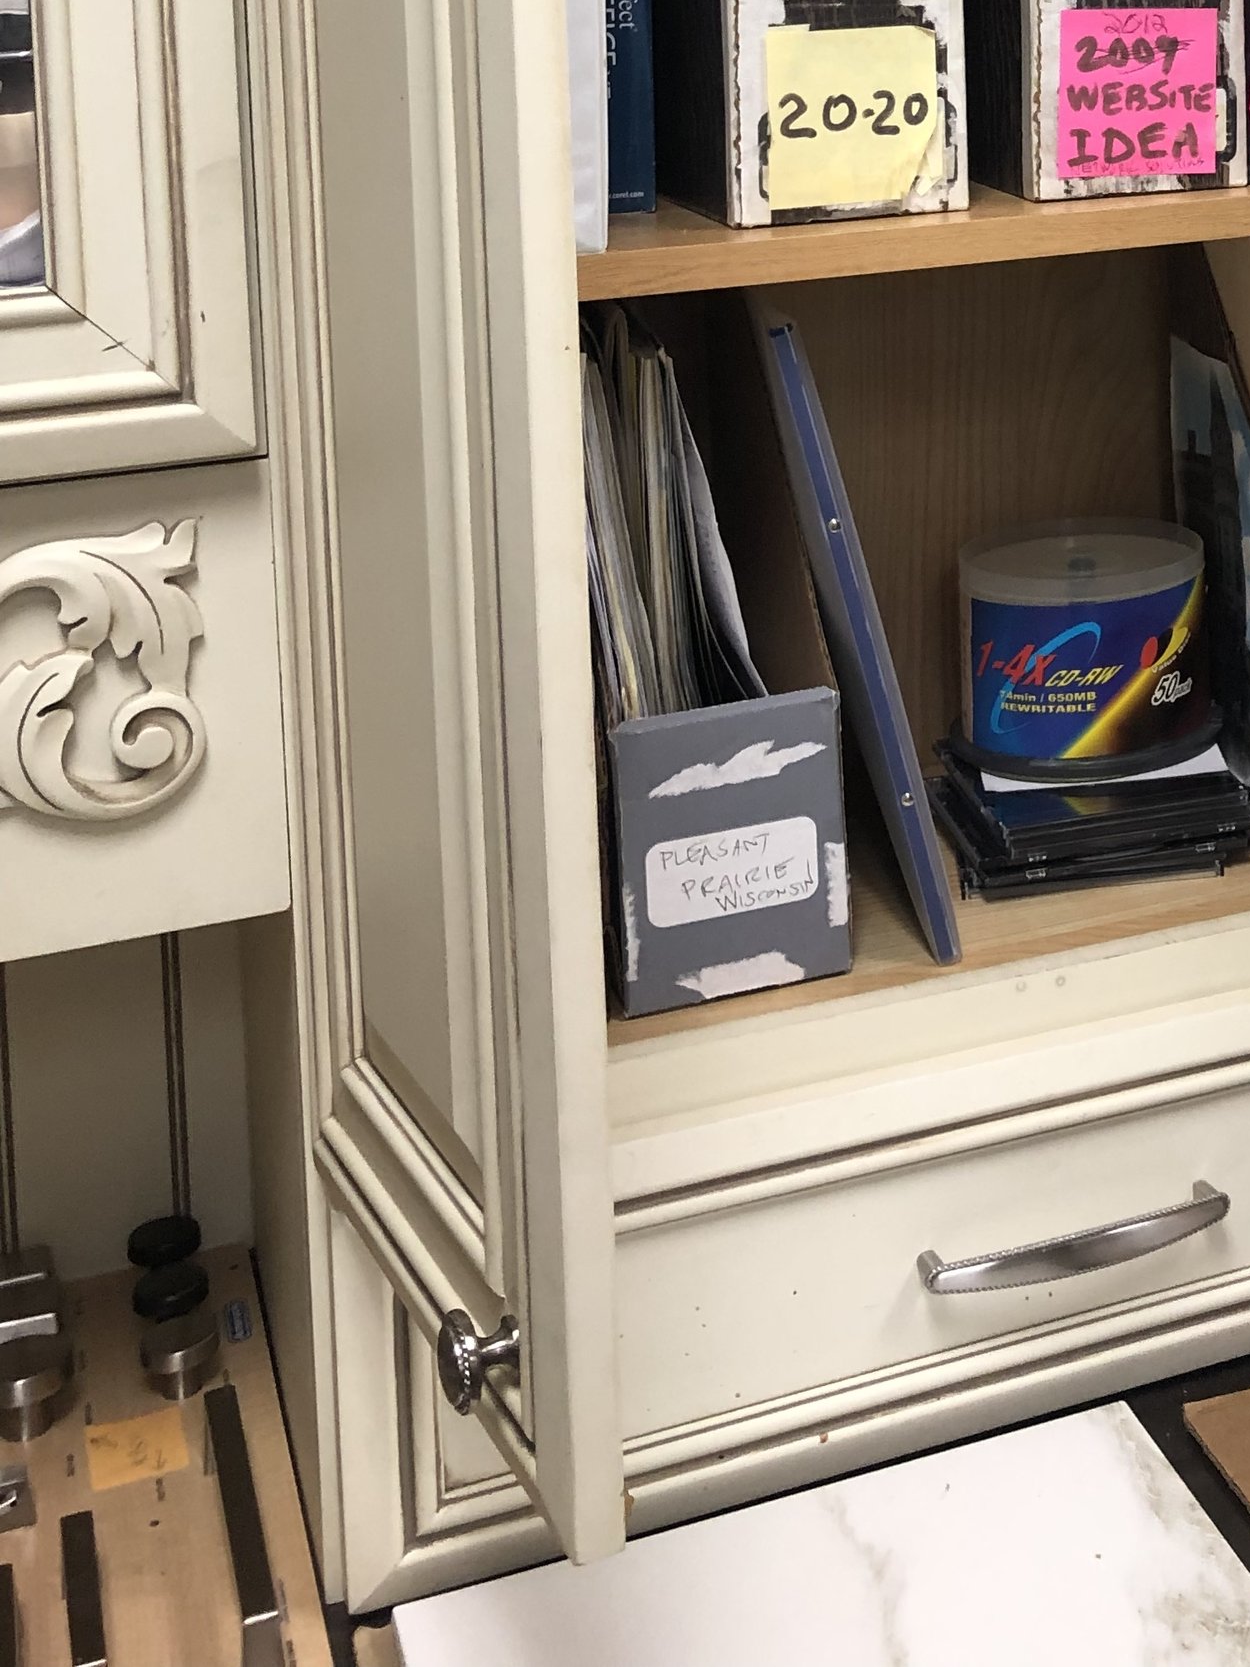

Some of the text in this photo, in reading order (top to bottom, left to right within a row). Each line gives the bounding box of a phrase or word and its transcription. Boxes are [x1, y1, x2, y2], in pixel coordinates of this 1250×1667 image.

[1103, 13, 1168, 34] 2012
[1066, 79, 1215, 116] WEBSITE
[1067, 122, 1199, 168] IDEA
[1045, 664, 1124, 688] CD-RW
[1152, 671, 1180, 705] 50
[1000, 701, 1097, 714] REWRITABLE
[1048, 691, 1097, 703] 650MB
[659, 832, 770, 870] PLEASANT
[681, 856, 795, 901] PRAIRIE
[714, 858, 814, 912] WISCONSIN
